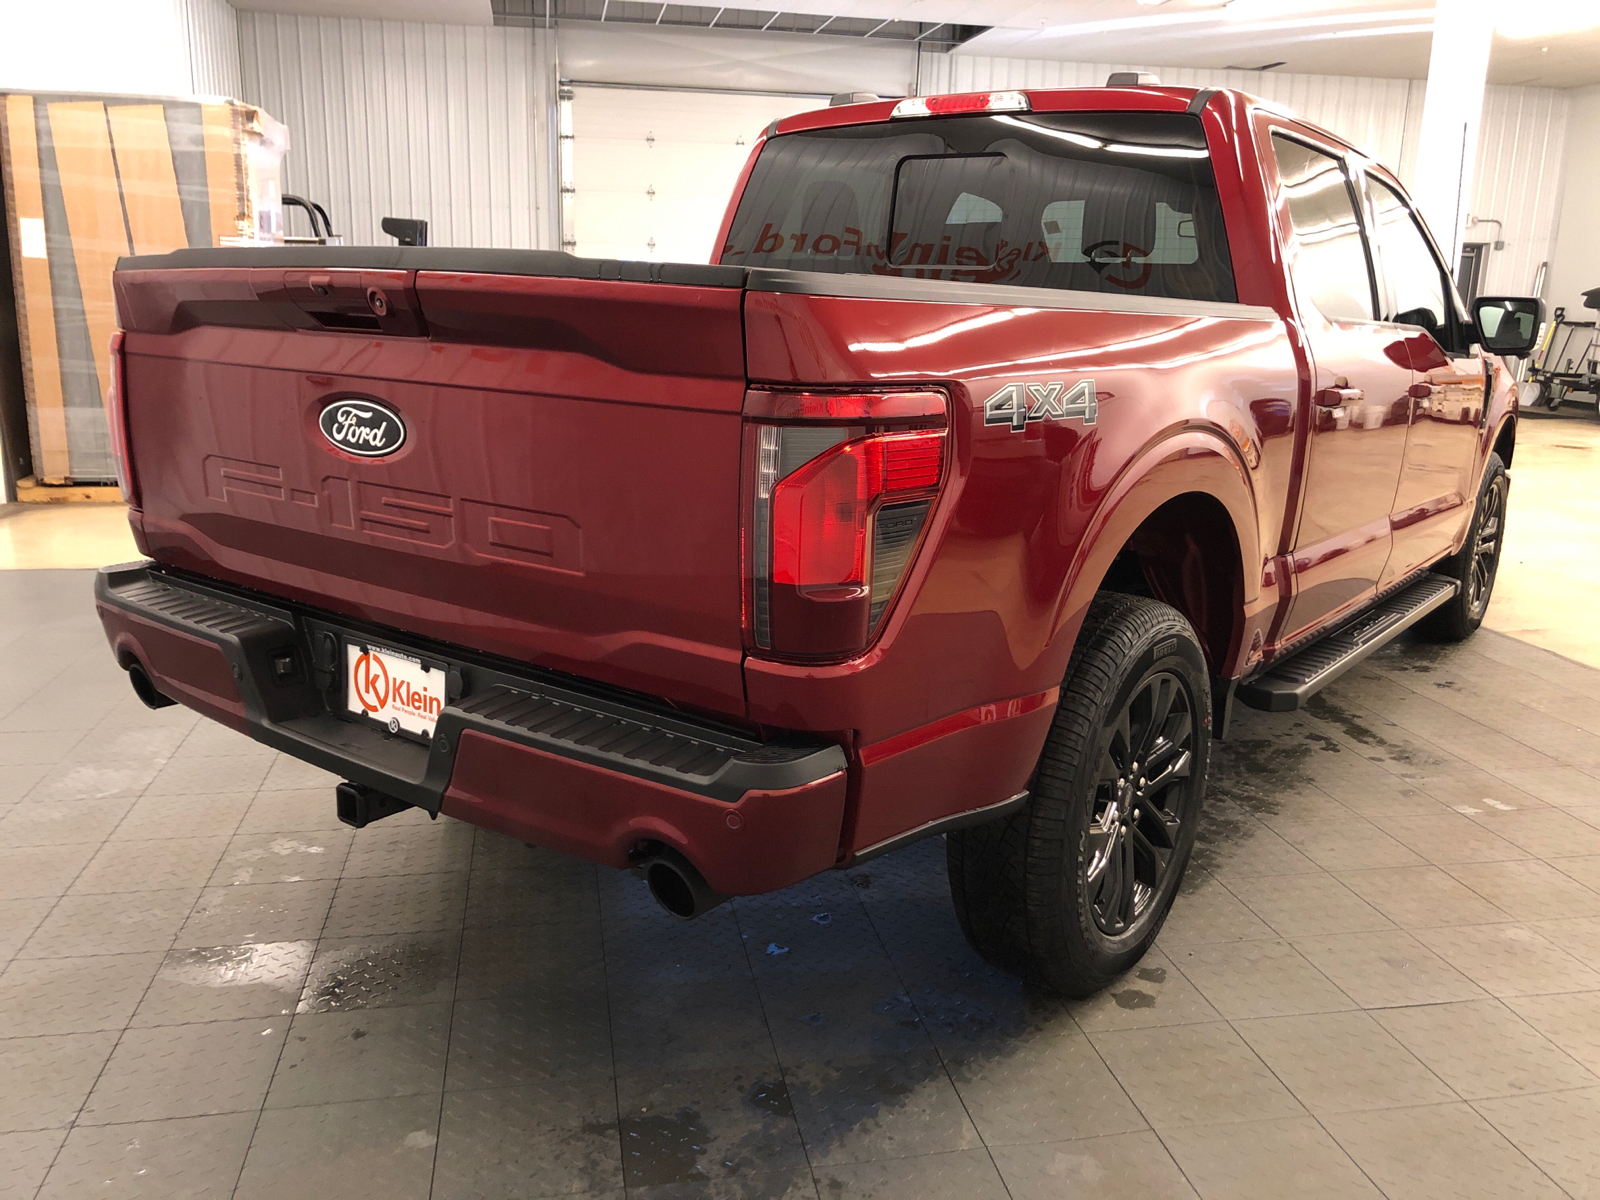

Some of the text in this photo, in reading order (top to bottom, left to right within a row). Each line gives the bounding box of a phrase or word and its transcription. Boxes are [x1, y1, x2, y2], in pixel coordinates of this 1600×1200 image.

[332, 406, 387, 447] Ford
[203, 454, 585, 576] F-150
[392, 677, 441, 716] Klein
